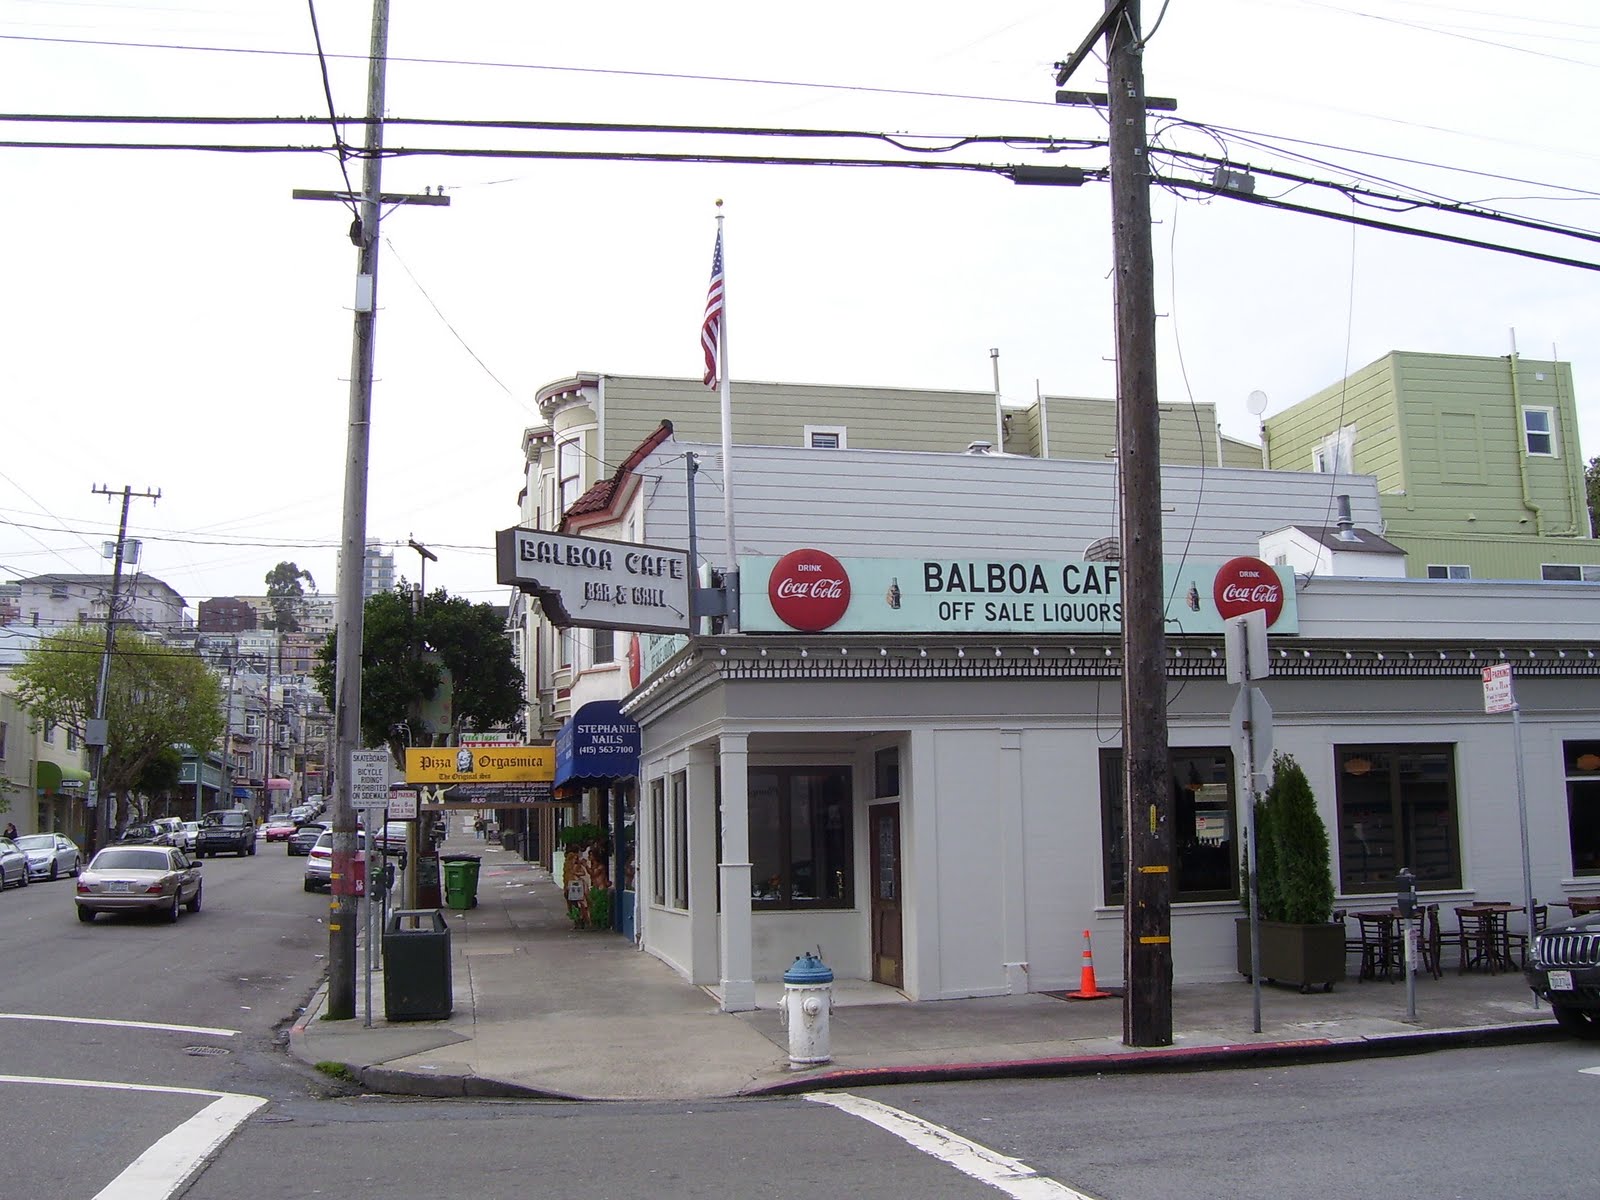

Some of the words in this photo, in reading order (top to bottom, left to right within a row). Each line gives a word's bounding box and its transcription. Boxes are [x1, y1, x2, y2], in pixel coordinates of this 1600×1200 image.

[520, 539, 612, 571] BALBOA
[625, 552, 685, 580] CAFE
[797, 564, 822, 572] DRINK
[924, 562, 1049, 594] BALBOA
[1063, 564, 1120, 595] CAF
[1239, 570, 1260, 578] DRINK
[777, 577, 844, 599] Coca-Cola
[584, 581, 610, 602] BAR
[632, 586, 667, 608] GRILL
[1222, 583, 1279, 603] Coca-Cola
[938, 601, 976, 622] OFF
[985, 602, 1035, 622] SALE
[1043, 602, 1122, 623] LIQUORS
[577, 724, 637, 734] STEPHANIE
[591, 735, 624, 744] NAILS
[579, 746, 597, 755] (415)
[599, 746, 634, 754] 563-7100
[353, 754, 388, 762] SKATEBOARD
[419, 756, 452, 771] Pizza
[478, 755, 544, 770] Orgasmica
[357, 768, 383, 776] BICYCLE
[452, 772, 478, 781] Original
[353, 784, 388, 792] PROHIBITED
[352, 792, 360, 800] ON
[361, 792, 388, 800] SIDEWALK
